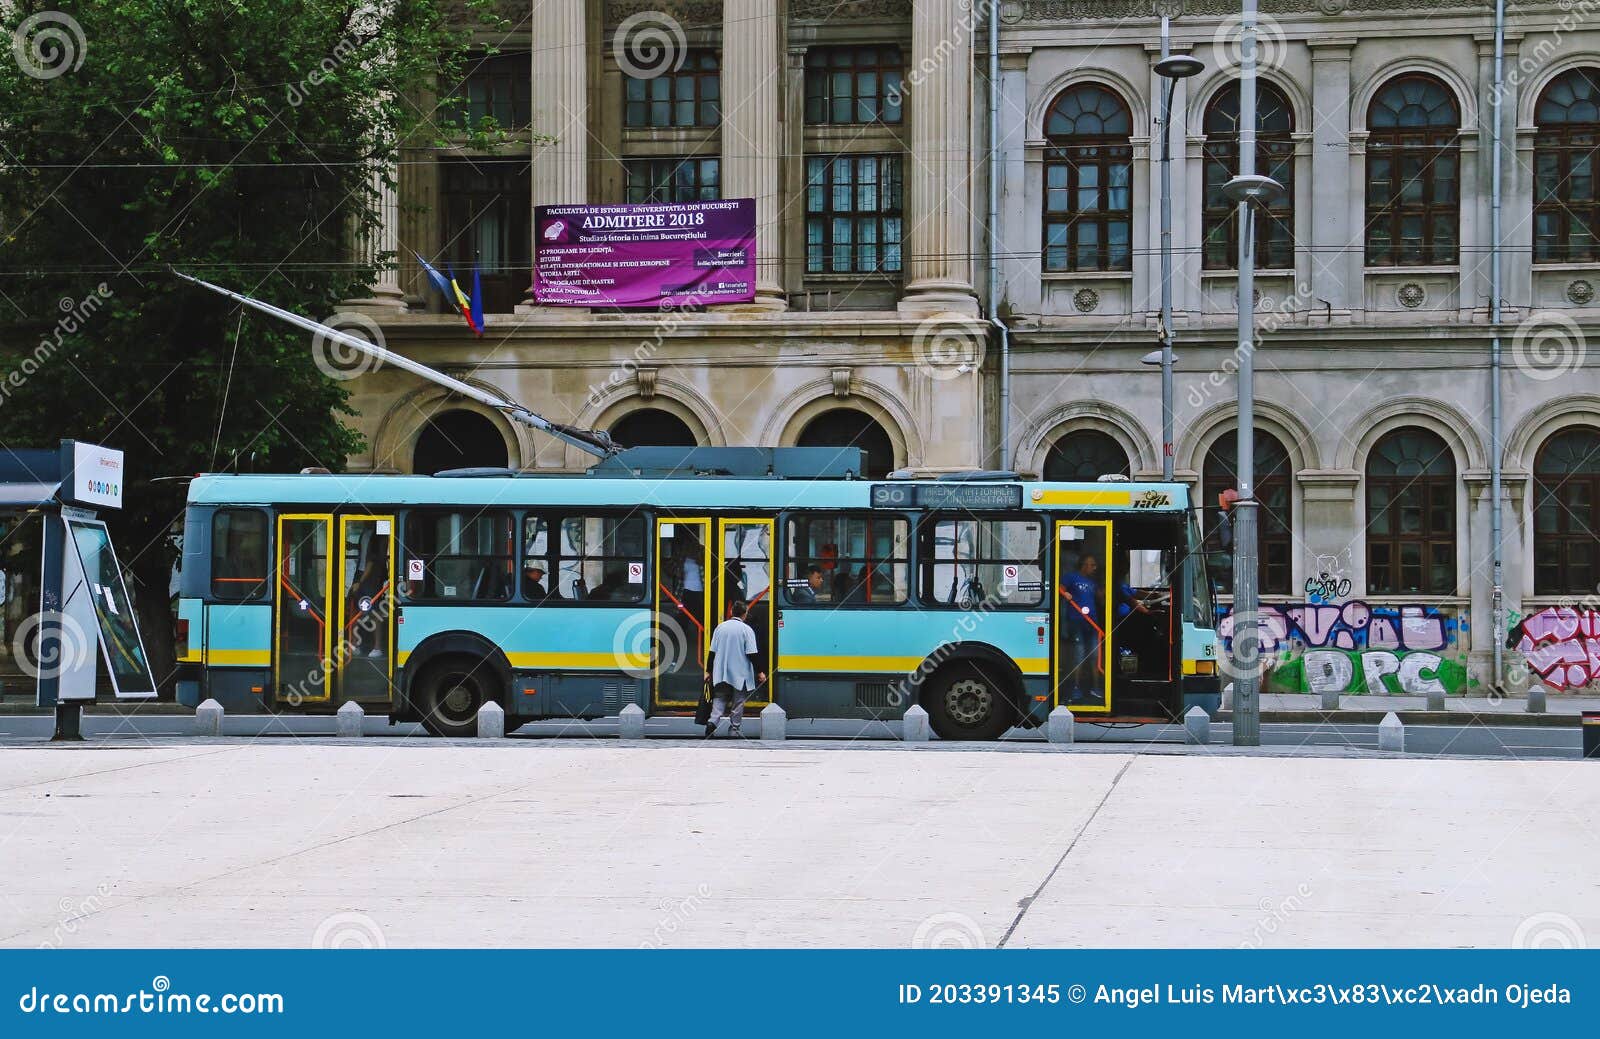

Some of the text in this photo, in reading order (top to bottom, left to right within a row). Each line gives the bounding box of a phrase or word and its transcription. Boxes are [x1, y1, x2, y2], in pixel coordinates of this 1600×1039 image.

[547, 207, 588, 215] FACULTATEA
[632, 204, 687, 214] UNIVERSITATEA
[582, 212, 705, 229] ADMITERE 2018
[875, 488, 905, 503] 90
